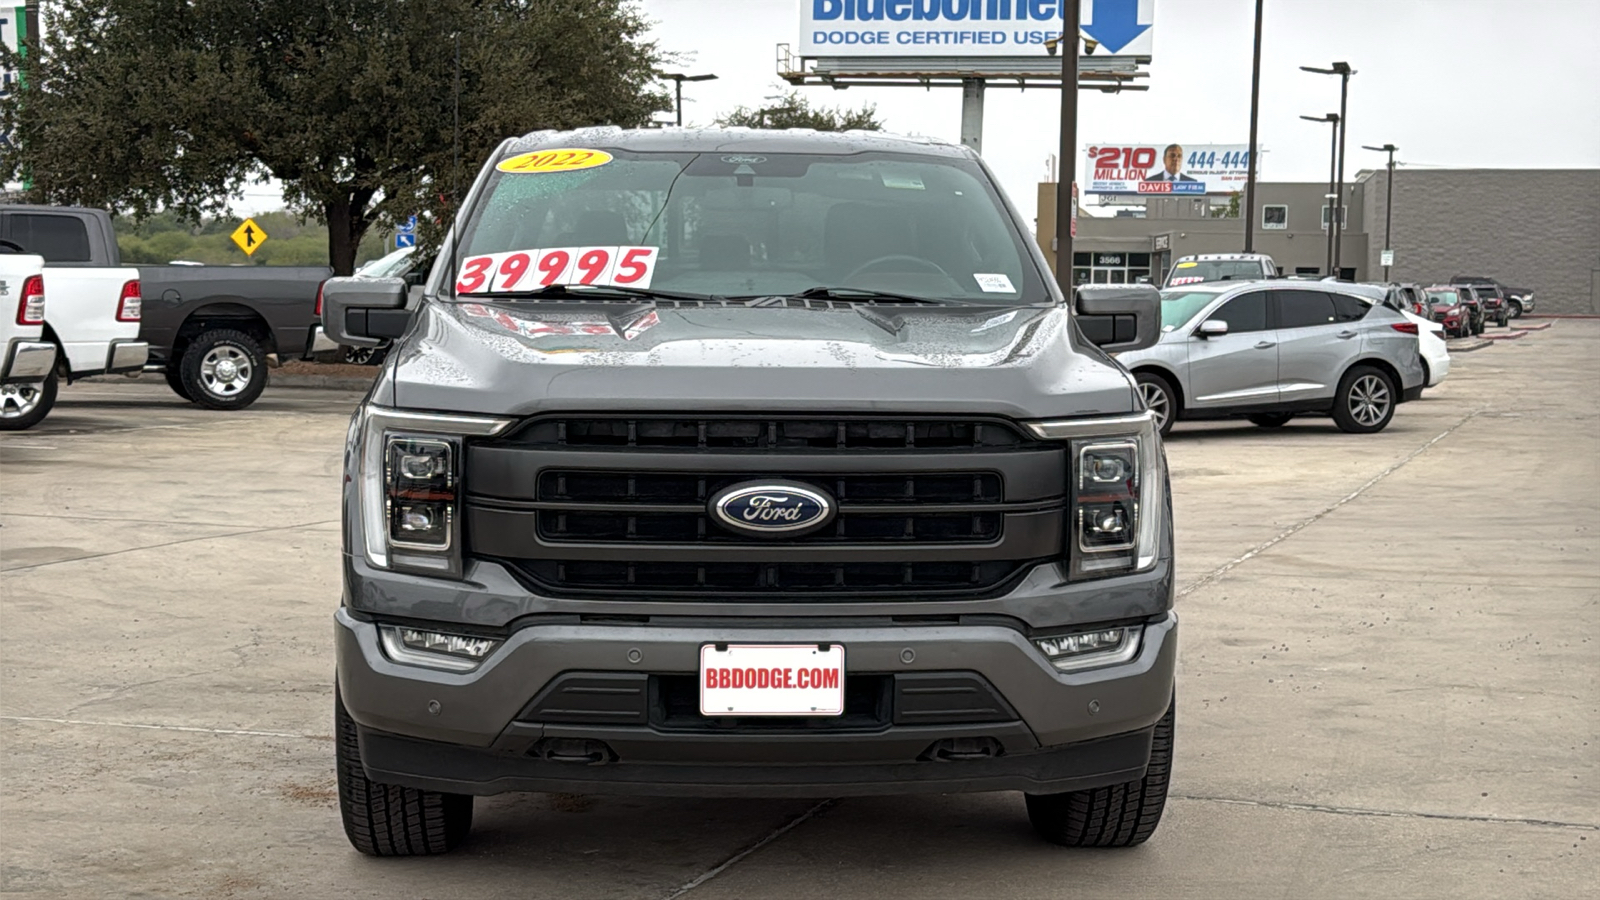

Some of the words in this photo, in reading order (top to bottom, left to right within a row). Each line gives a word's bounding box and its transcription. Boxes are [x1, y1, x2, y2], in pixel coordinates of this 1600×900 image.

[813, 31, 890, 44] DODGE
[896, 31, 1007, 44] CERTIFIED
[1013, 31, 1064, 44] USE
[512, 152, 594, 169] 2022
[1088, 146, 1157, 169] $210
[1187, 151, 1258, 169] 444-444
[1094, 168, 1147, 180] MILLION
[1139, 183, 1171, 192] DAVIS
[456, 249, 652, 293] 39995
[743, 495, 803, 520] Ford
[706, 667, 839, 689] BBDODGE.COM
